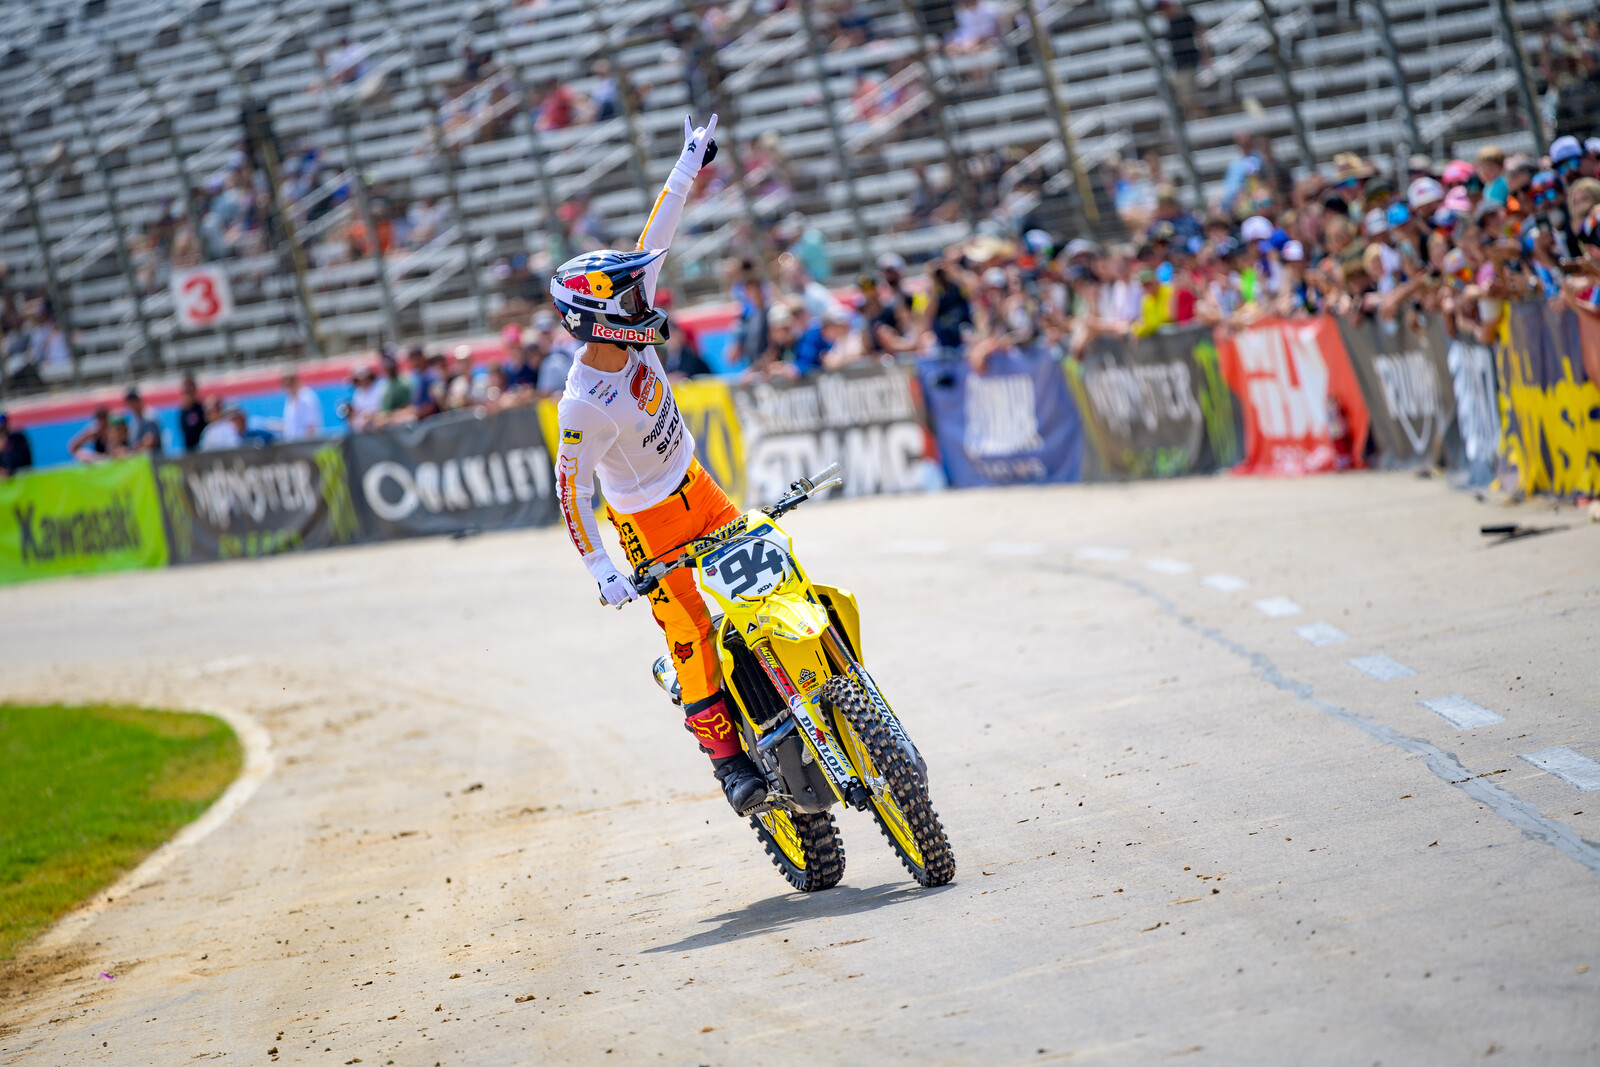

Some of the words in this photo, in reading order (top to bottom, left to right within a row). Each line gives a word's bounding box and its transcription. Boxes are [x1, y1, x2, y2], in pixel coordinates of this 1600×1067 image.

[183, 275, 220, 323] 3
[593, 323, 624, 339] Red
[625, 328, 655, 342] Bull
[637, 366, 656, 411] CHERRY
[14, 489, 141, 567] Kawasaki
[620, 521, 670, 606] CHEY
[718, 539, 784, 600] 94
[800, 715, 847, 776] DUNLOP
